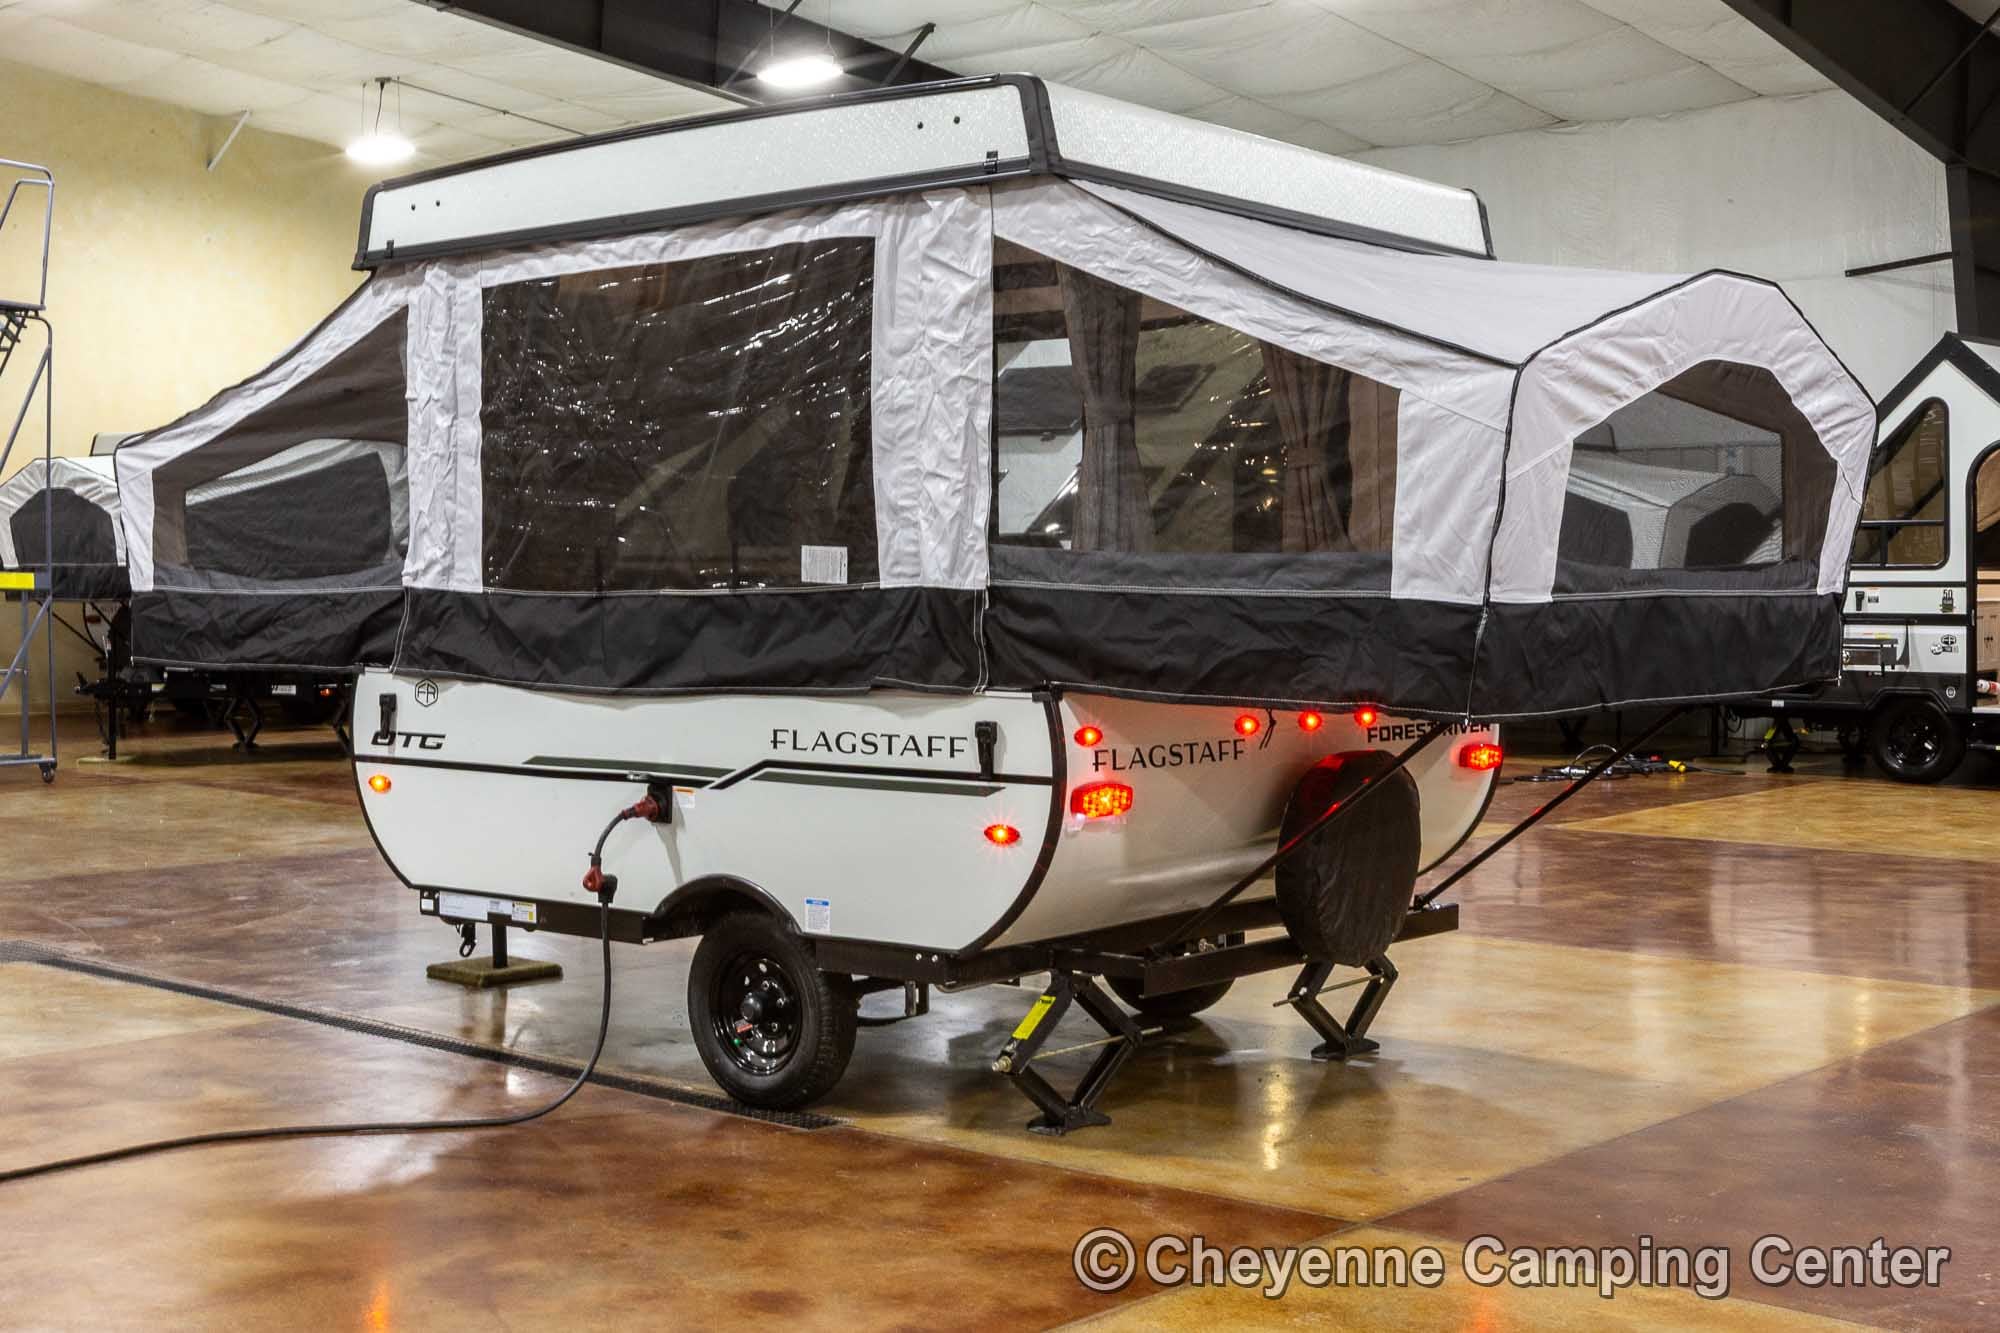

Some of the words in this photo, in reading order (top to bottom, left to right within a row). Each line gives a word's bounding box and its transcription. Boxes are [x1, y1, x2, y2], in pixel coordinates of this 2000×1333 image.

[371, 730, 446, 750] OTG
[770, 728, 968, 759] FLAGSTAFF
[1092, 738, 1245, 772] FLAGSTAFF
